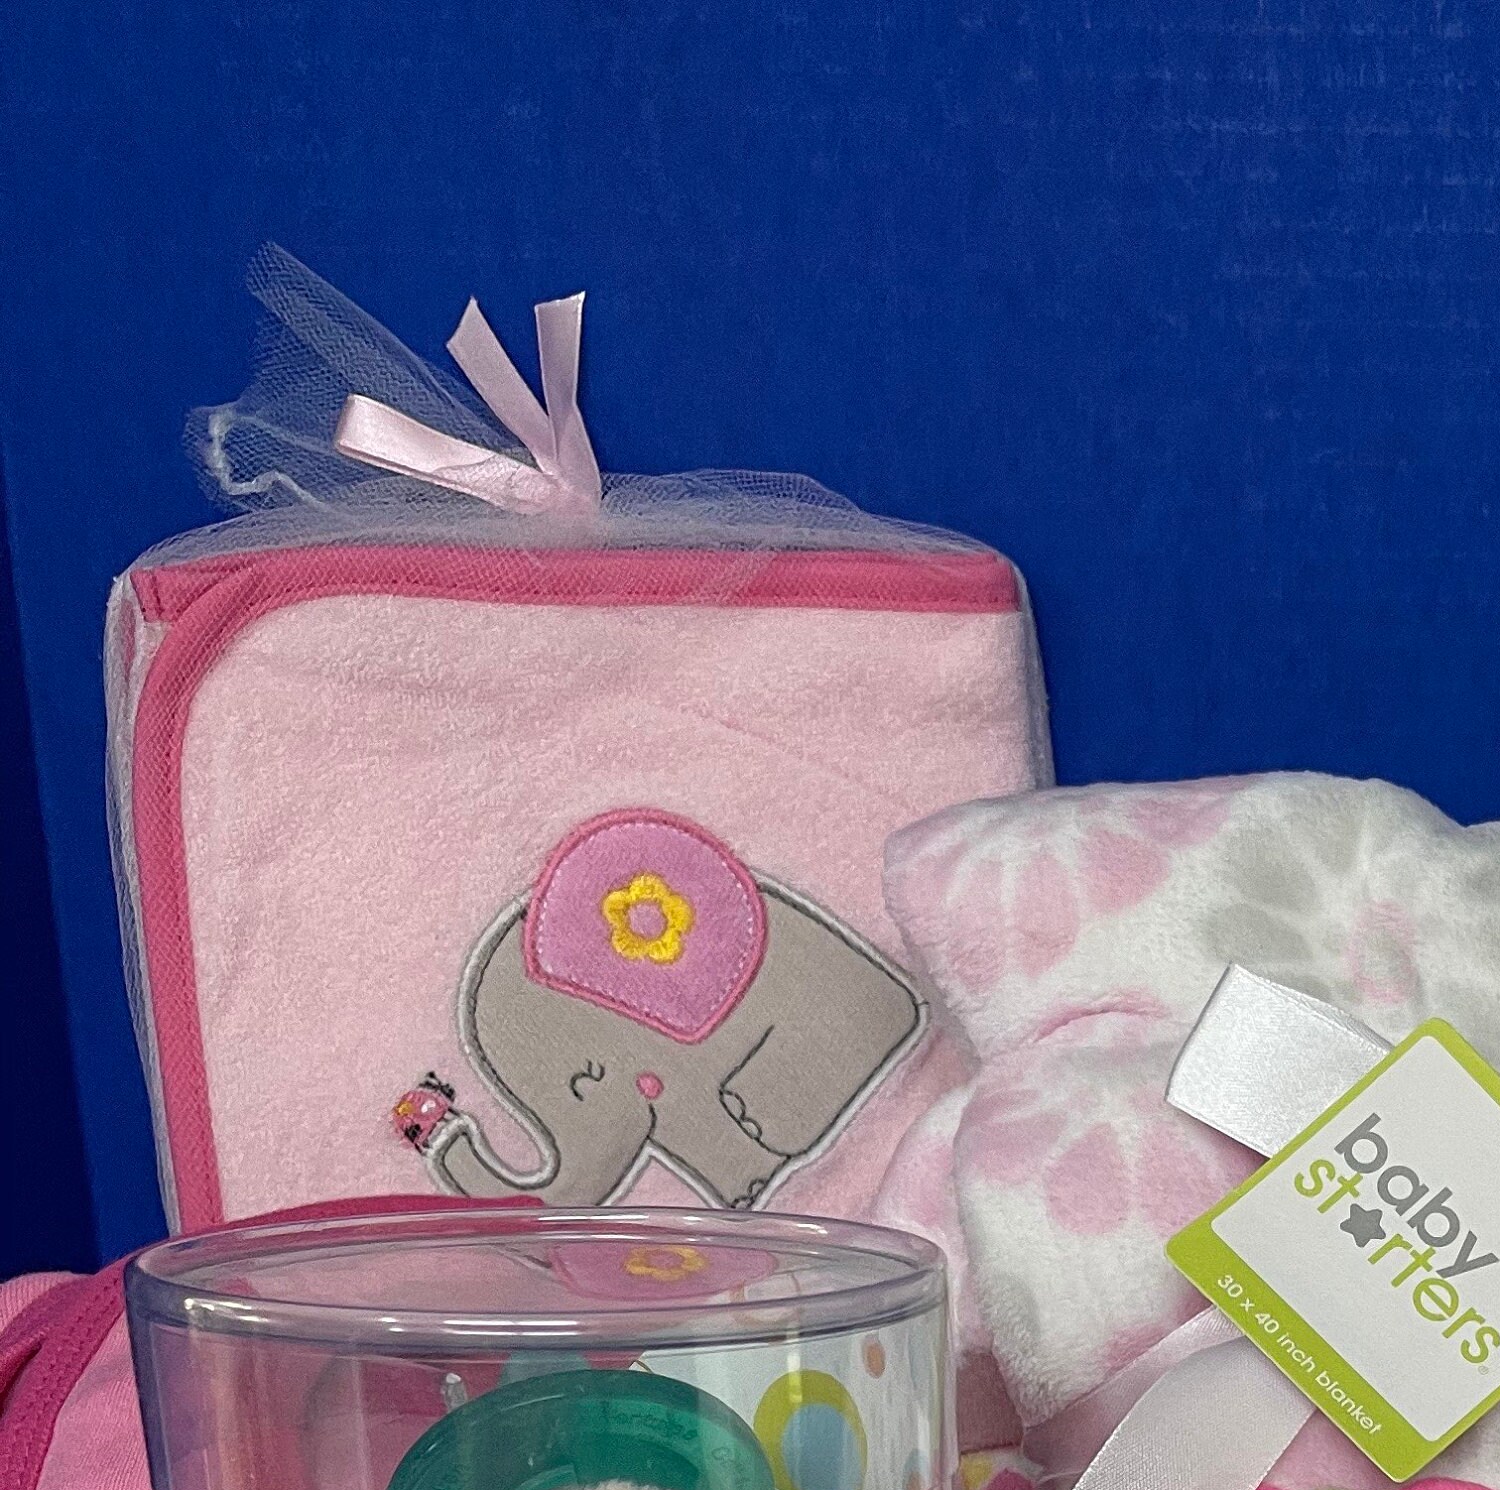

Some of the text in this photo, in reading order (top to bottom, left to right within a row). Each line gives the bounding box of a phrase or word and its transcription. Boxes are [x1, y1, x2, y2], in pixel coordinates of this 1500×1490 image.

[1333, 1112, 1500, 1279] baby
[1217, 1274, 1383, 1434] 30 x 40 inch blanket
